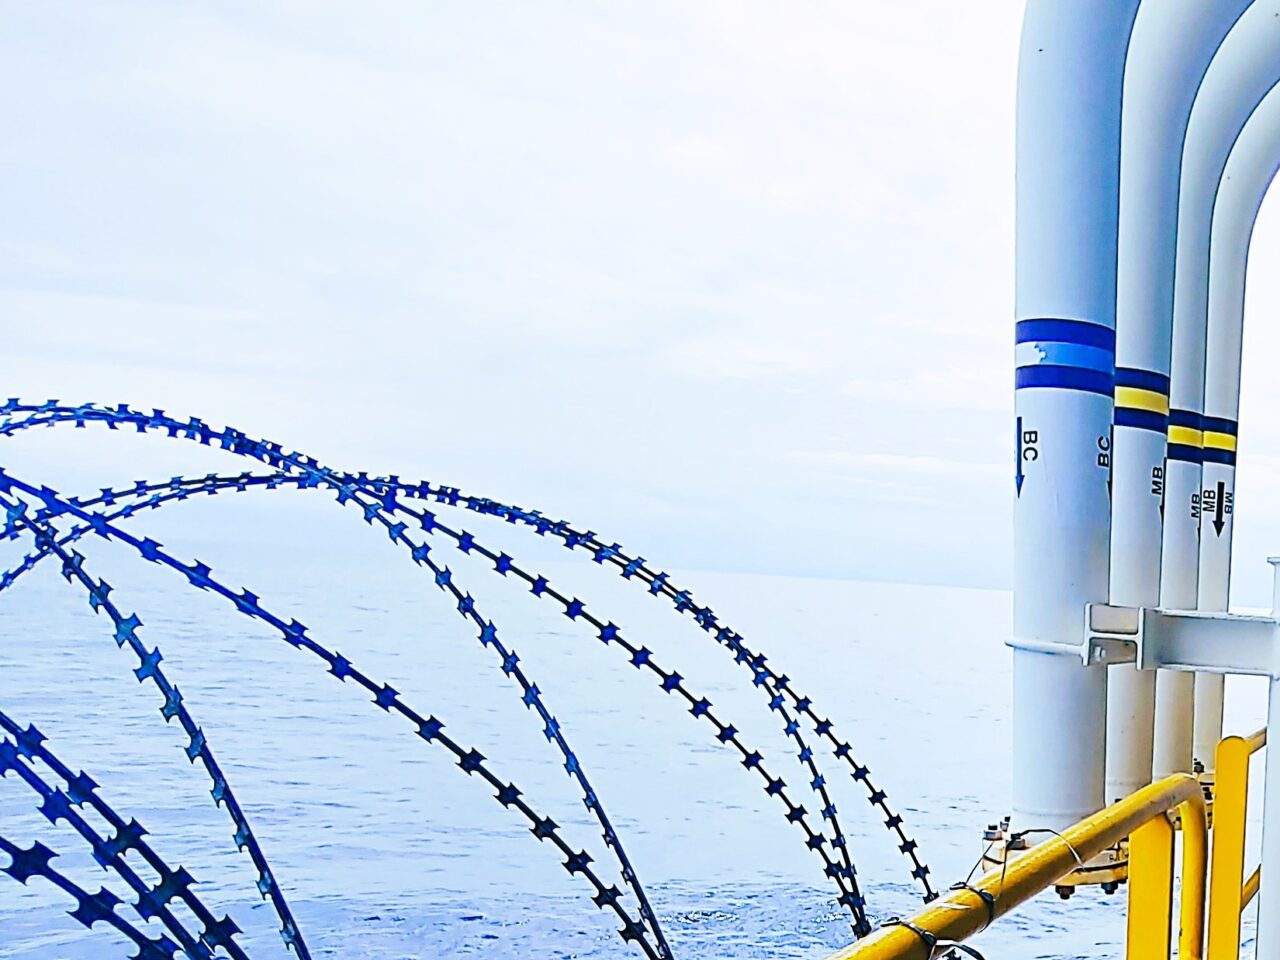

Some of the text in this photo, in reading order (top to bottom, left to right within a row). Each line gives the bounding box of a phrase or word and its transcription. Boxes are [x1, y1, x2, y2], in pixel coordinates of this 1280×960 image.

[1023, 430, 1038, 461] BC
[1097, 435, 1110, 467] BC
[1151, 466, 1163, 495] MB
[1191, 493, 1200, 518] MB
[1202, 489, 1216, 513] MB
[1224, 491, 1233, 515] MB
